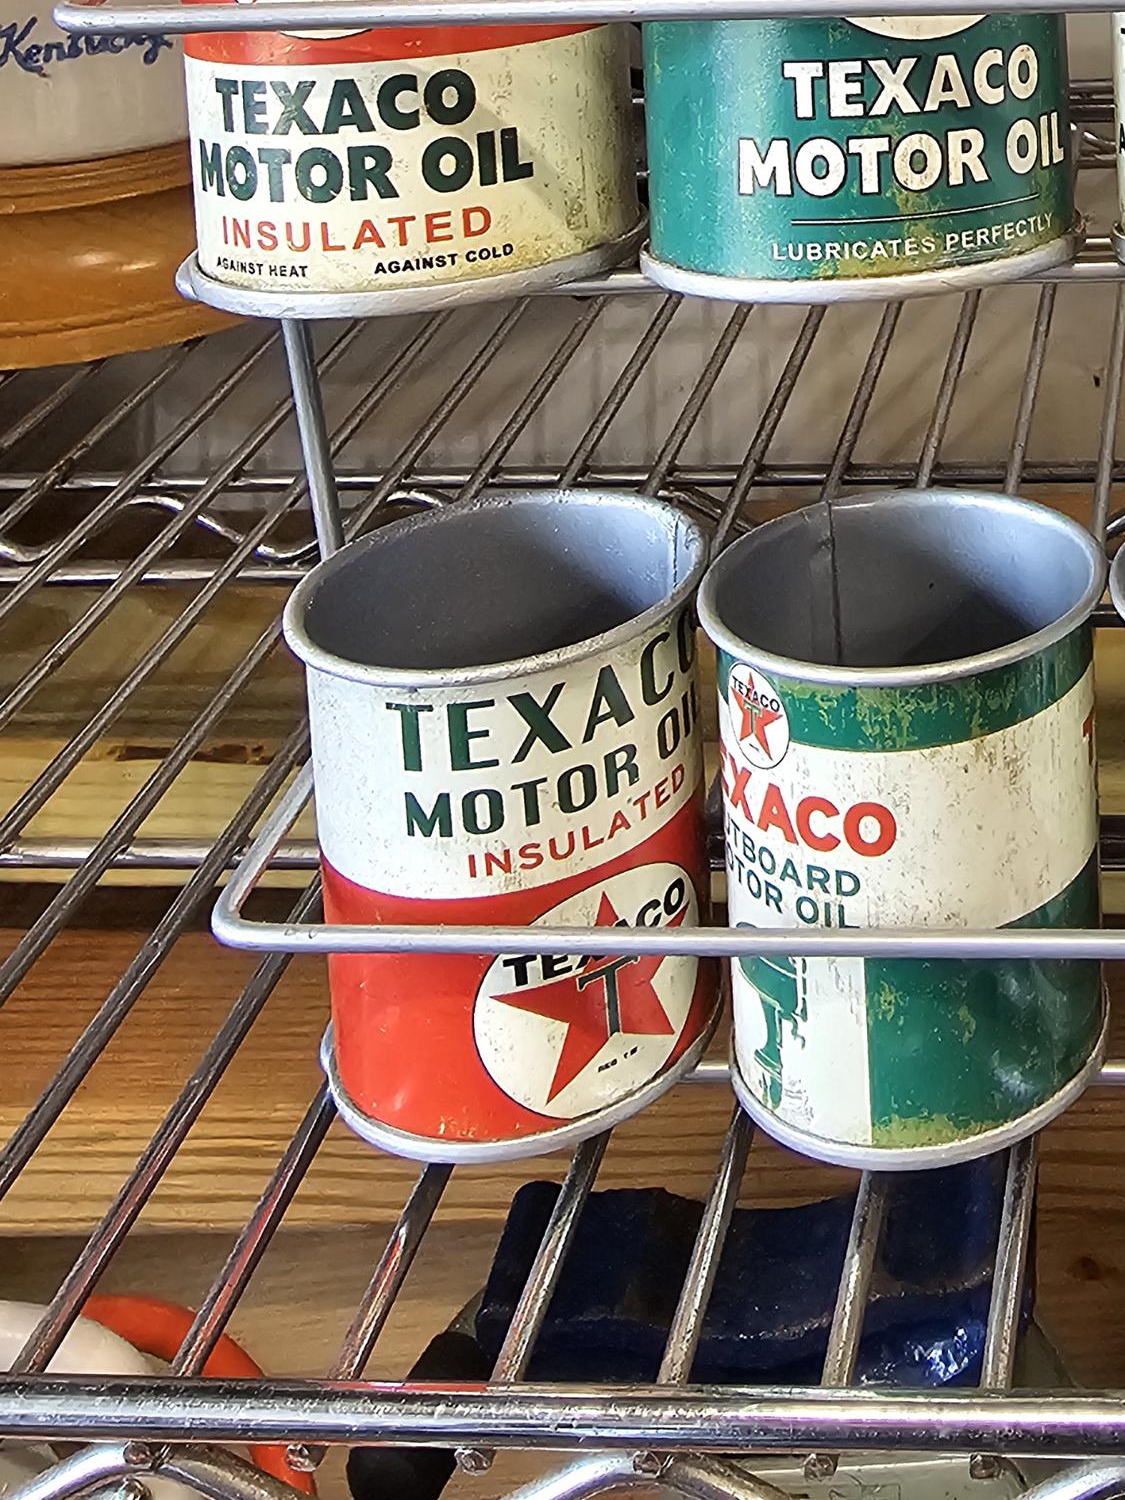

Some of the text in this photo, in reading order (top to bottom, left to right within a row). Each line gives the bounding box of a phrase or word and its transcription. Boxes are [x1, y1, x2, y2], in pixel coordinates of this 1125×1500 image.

[216, 70, 476, 136] TEXACO
[784, 43, 1038, 120] TEXACO
[199, 127, 534, 204] MOTOR OIL
[737, 111, 1065, 198] MOTOR OIL
[216, 256, 308, 278] AGAINST HEAT
[222, 205, 492, 254] INSULATED
[374, 243, 514, 275] AGAINST COLD
[773, 212, 1054, 261] LUBRICATES PERFECTLY
[386, 607, 695, 772] TEXACO
[732, 675, 780, 713] TEXACO
[404, 743, 640, 838] MOTOR
[468, 763, 685, 878] INSULATED
[720, 737, 897, 857] XACO
[726, 841, 860, 929] OTOR OIL
[727, 812, 861, 896] TBOARD
[503, 877, 685, 987] TECO
